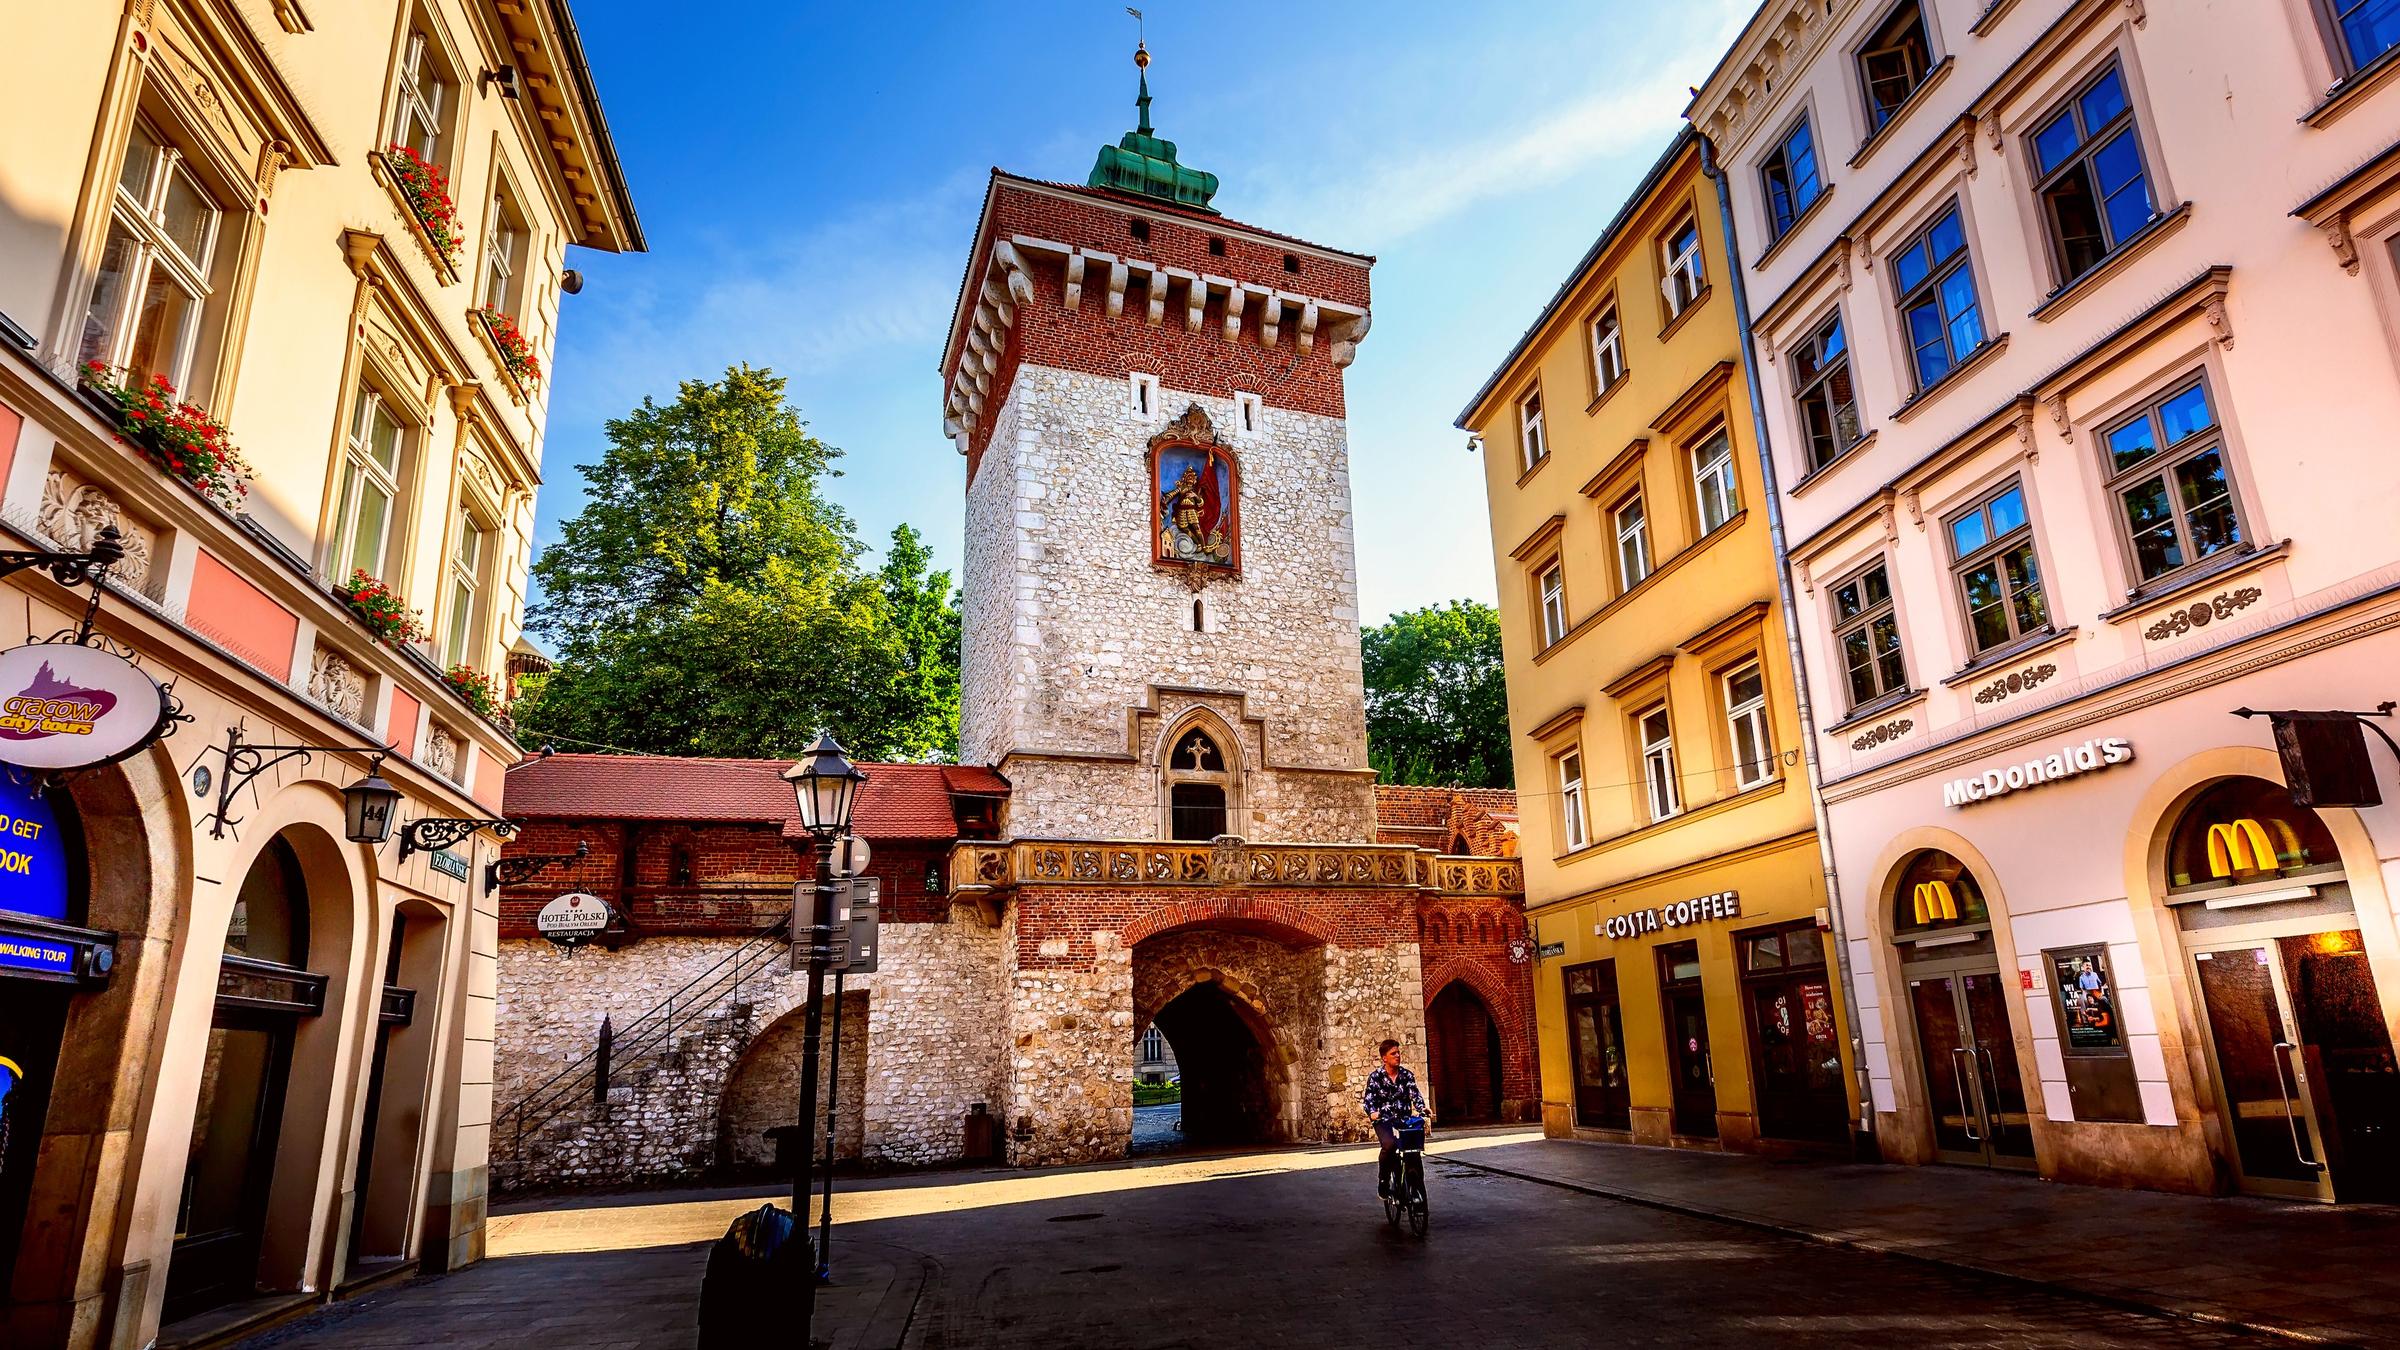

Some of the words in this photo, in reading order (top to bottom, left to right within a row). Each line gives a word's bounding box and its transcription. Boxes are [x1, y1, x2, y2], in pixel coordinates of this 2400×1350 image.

[4, 697, 101, 720] cracow
[0, 713, 40, 733] city
[41, 719, 95, 735] tours
[1943, 737, 2130, 807] McDonald's
[366, 805, 385, 821] 44
[12, 819, 43, 840] GET
[541, 914, 571, 922] HOTEL
[573, 912, 605, 922] POLSKI
[1606, 909, 1659, 939] COSTA
[1664, 891, 1738, 927] COFFEE
[1509, 940, 1526, 948] COSTA
[0, 943, 41, 959] WALKING
[43, 949, 67, 963] TOUR
[1509, 954, 1529, 964] COFFEE
[2063, 983, 2075, 992] WI
[2069, 991, 2079, 999] TA
[2065, 998, 2078, 1007] MY
